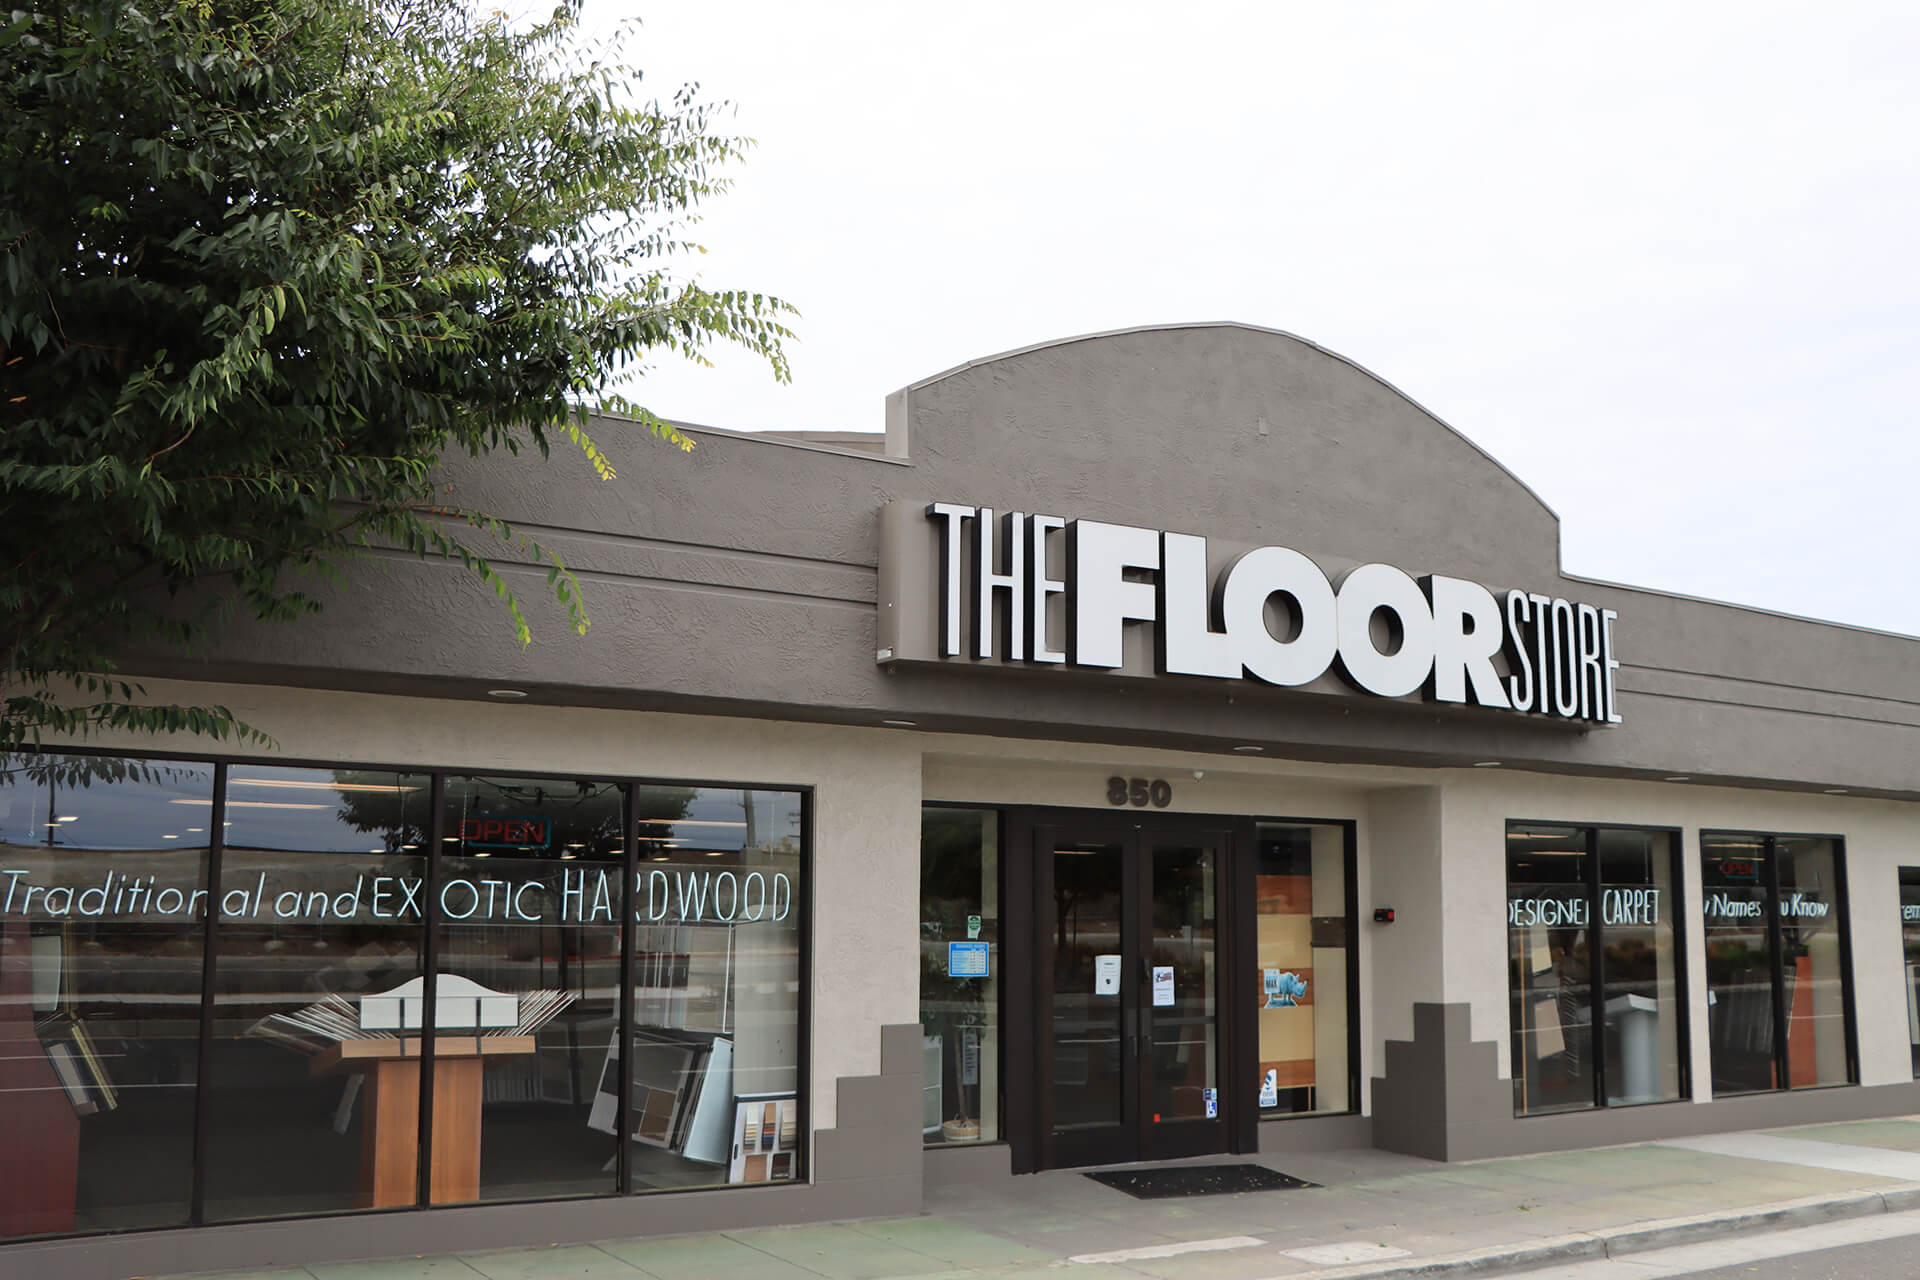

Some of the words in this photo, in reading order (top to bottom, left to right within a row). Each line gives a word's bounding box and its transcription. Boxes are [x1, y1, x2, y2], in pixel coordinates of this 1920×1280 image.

[926, 502, 1066, 664] THE
[1074, 518, 1513, 710] FLOOR
[1501, 588, 1624, 724] STORE
[1107, 776, 1172, 809] 850
[459, 818, 545, 843] OPEN
[1721, 860, 1754, 876] OPEN
[1, 869, 266, 918] Traditional
[273, 873, 363, 919] and
[1602, 888, 1660, 925] CARPET
[1712, 892, 1762, 918] Names
[1791, 892, 1829, 917] Know
